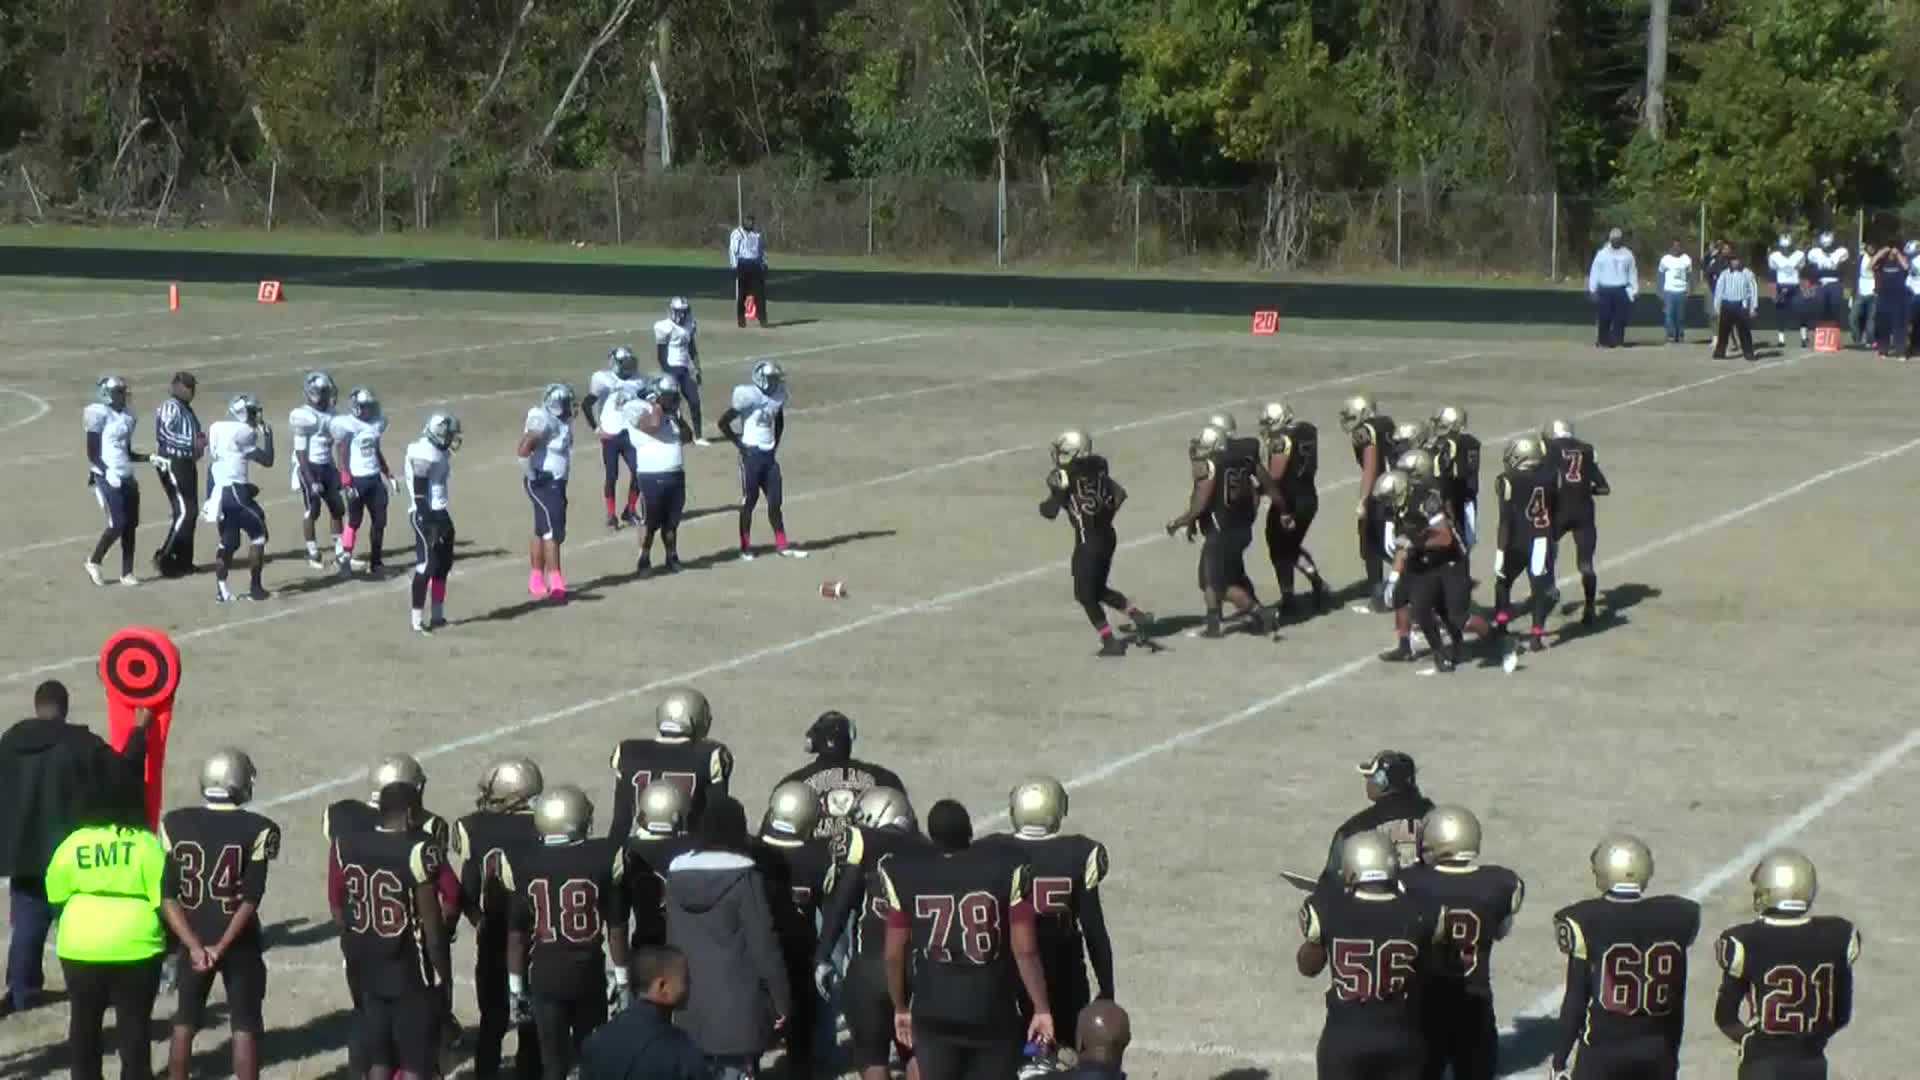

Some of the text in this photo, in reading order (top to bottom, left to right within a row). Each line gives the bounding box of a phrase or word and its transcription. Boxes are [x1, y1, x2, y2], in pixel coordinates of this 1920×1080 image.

[1255, 313, 1274, 330] 20
[1561, 449, 1583, 483] 7
[1526, 486, 1550, 528] 4
[75, 841, 136, 870] EMT
[170, 840, 243, 915] 34
[342, 863, 408, 938] 36
[527, 878, 600, 943] 18
[914, 890, 1001, 965] 78
[1332, 937, 1419, 1002] 56
[1600, 941, 1683, 1017] 68
[1761, 962, 1835, 1034] 21
